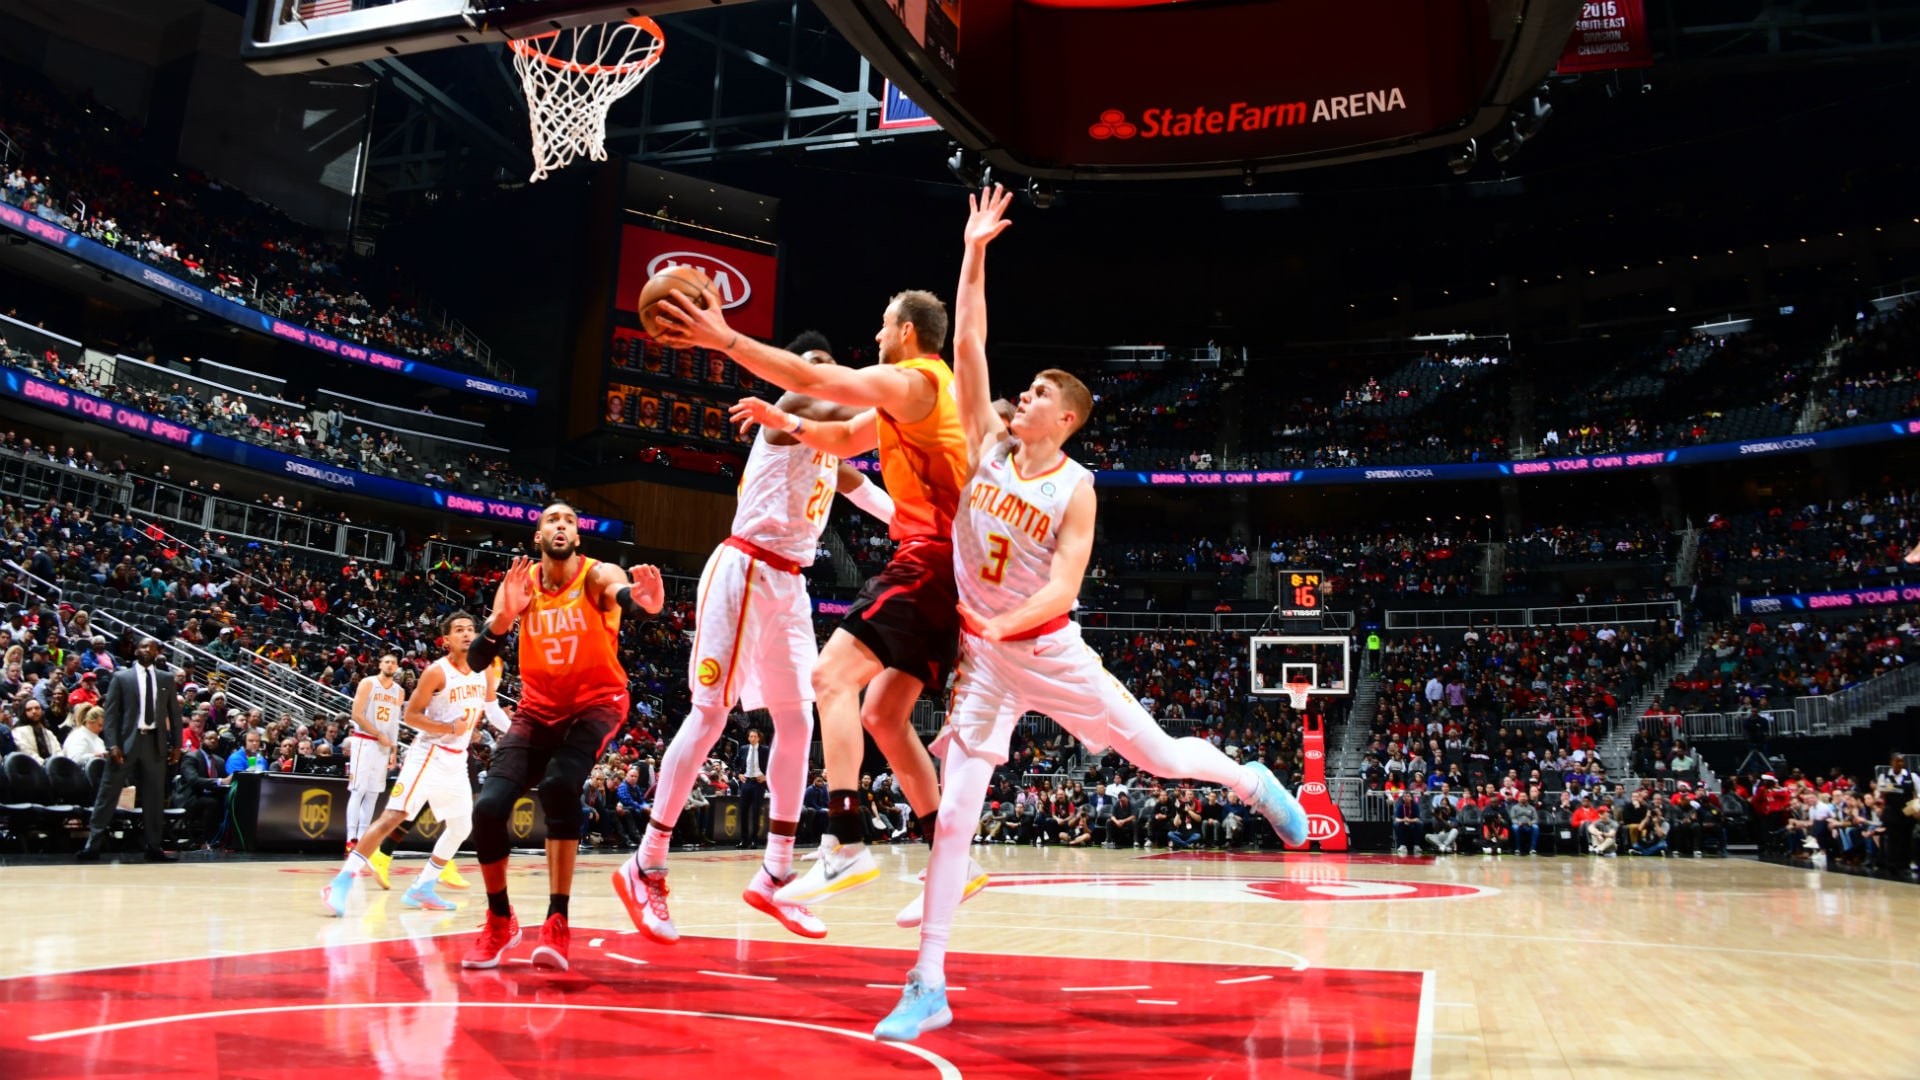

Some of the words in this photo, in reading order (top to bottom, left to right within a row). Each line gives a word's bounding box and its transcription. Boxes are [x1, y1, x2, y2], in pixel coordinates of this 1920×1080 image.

[1582, 1, 1617, 18] 2015
[1577, 41, 1630, 56] CHAMPIONS
[1584, 30, 1621, 43] DIVISION
[1311, 87, 1406, 122] ARENA
[27, 218, 67, 244] SPIRIT
[273, 321, 306, 341] BRING
[308, 333, 337, 352] YOUR
[340, 345, 367, 360] OWN
[370, 353, 404, 369] SPIRIT
[24, 380, 69, 406] BRING
[73, 395, 112, 419] YOUR
[117, 410, 148, 431] OWN
[151, 421, 191, 442] SPIRIT
[1513, 463, 1550, 474] BRING
[1553, 459, 1588, 470] YOUR
[1592, 457, 1622, 467] OWN
[1626, 453, 1664, 465] SPIRIT
[1151, 474, 1186, 483] BRING
[1188, 474, 1222, 483] YOUR
[1225, 474, 1253, 483] OWN
[1256, 472, 1291, 482] SPIRIT
[447, 495, 484, 513] BRING
[488, 503, 524, 519] YOUR
[968, 482, 1051, 542] ATLANTA
[979, 531, 1012, 584] 3
[1295, 586, 1315, 607] 16
[1809, 594, 1852, 609] BRING
[1856, 590, 1898, 603] YOUR
[528, 608, 588, 636] UTAH
[541, 635, 579, 664] 27
[376, 705, 391, 721] 25
[303, 804, 329, 830] ups
